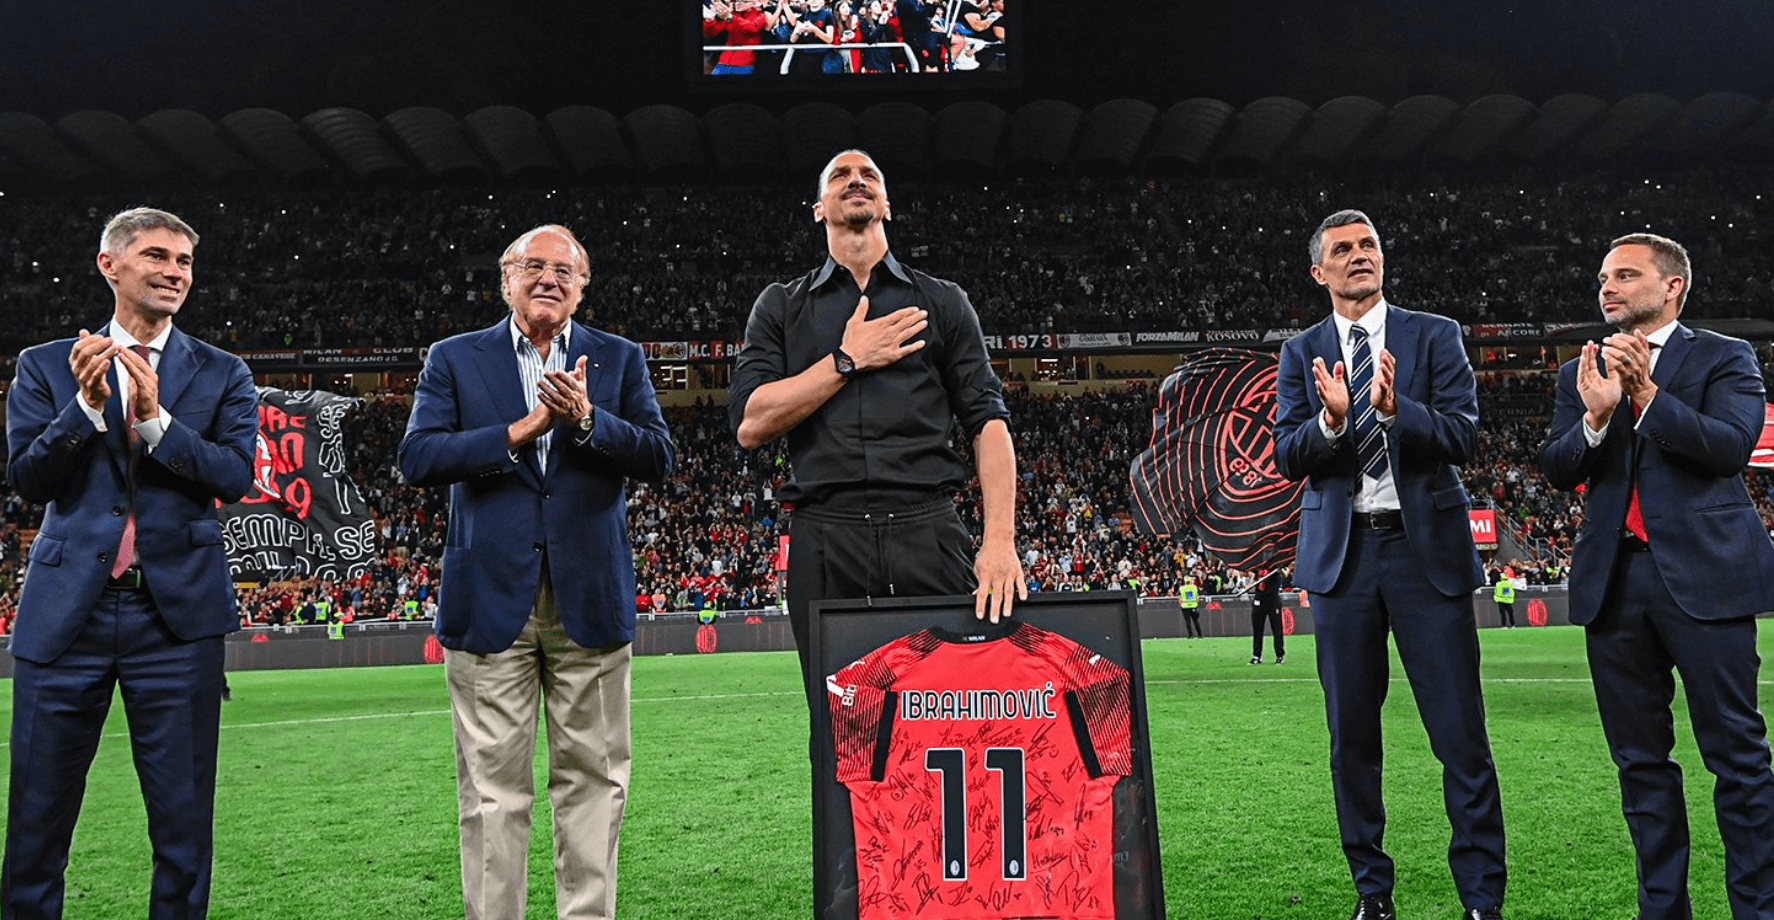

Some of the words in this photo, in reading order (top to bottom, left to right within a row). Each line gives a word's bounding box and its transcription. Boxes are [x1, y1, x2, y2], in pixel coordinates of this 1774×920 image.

[1206, 331, 1260, 343] KOSOVO
[901, 682, 1057, 721] IBRAHIMOVIĆ
[924, 747, 1027, 882] 11
